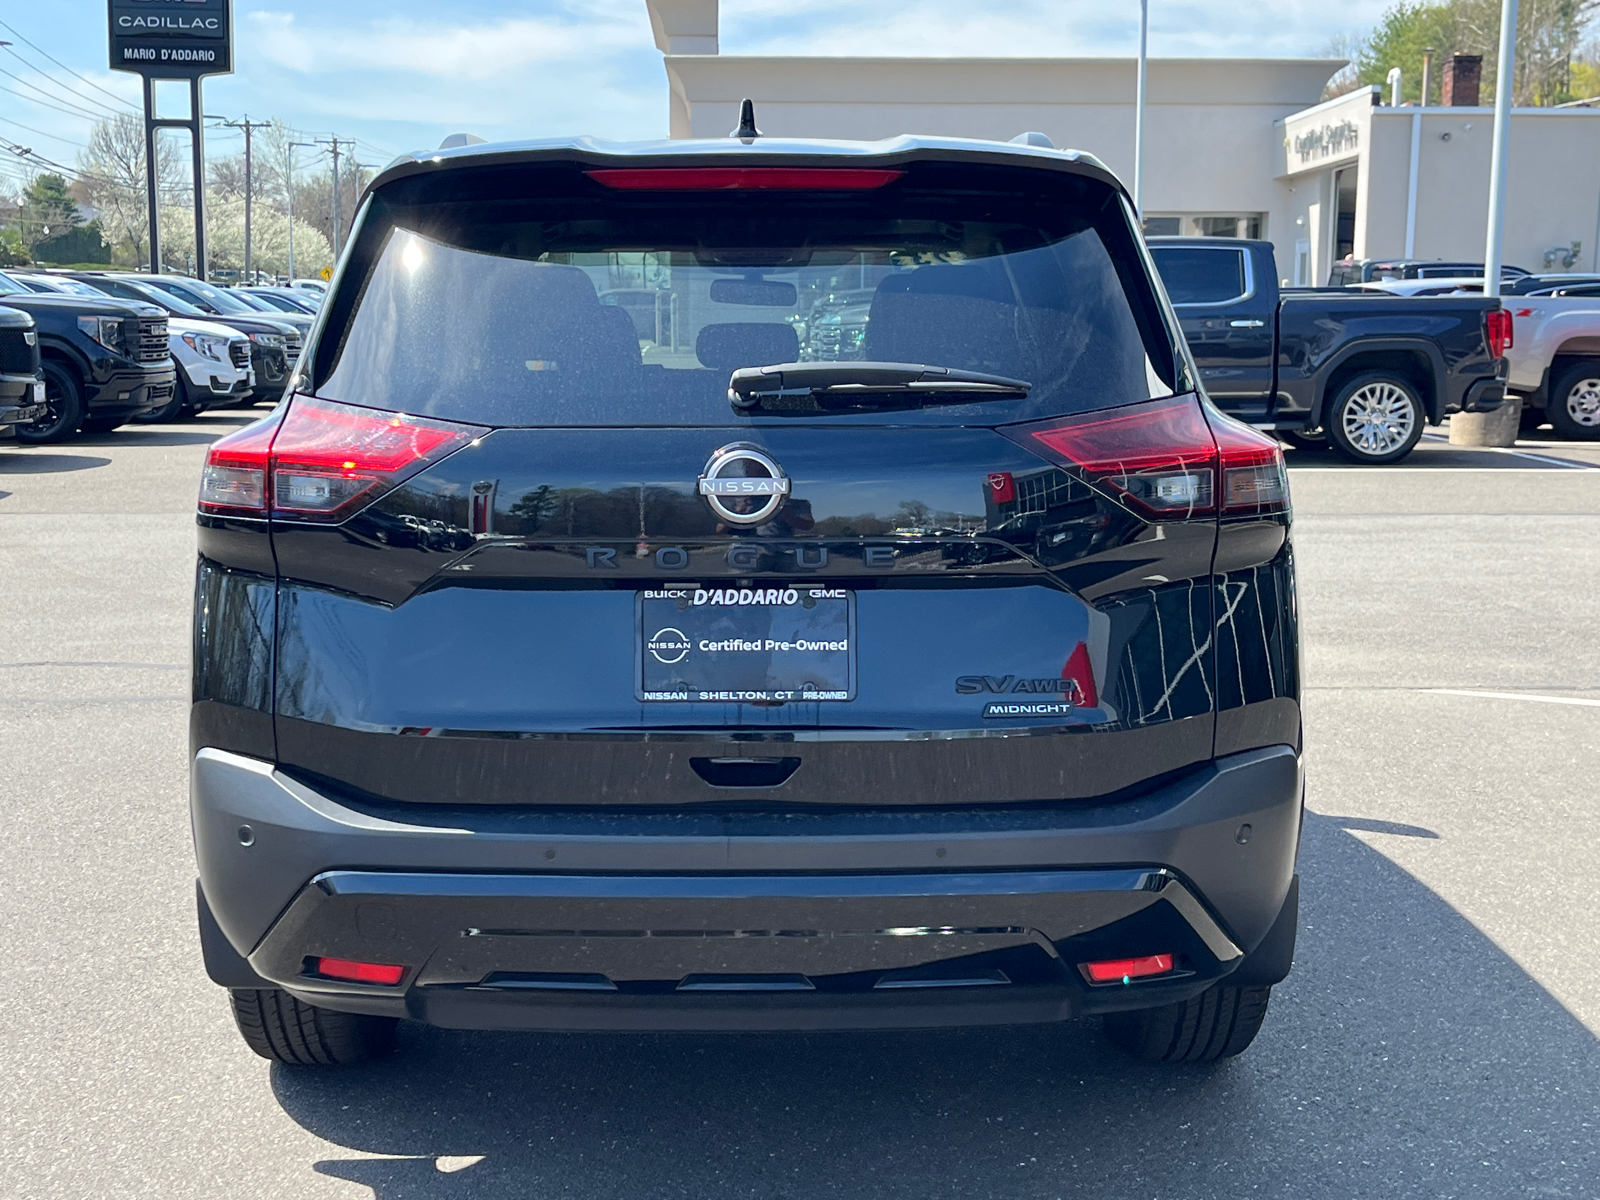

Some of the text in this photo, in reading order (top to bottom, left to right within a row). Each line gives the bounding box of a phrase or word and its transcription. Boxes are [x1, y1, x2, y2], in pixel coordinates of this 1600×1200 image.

[118, 16, 219, 29] CADILLAC
[124, 48, 215, 61] MARIO D'ADDARIO
[701, 480, 786, 492] NISSAN
[586, 546, 897, 570] ROGUE
[644, 590, 687, 599] BUICK
[693, 589, 798, 606] D'ADDARIO
[809, 589, 846, 598] GMC
[699, 639, 848, 651] Certified Pre-Owned
[644, 692, 688, 700] NISSAN
[699, 691, 795, 701] SHELTON, CT
[803, 691, 847, 700] PRE-OWNED
[989, 704, 1070, 714] MIDNIGHT
